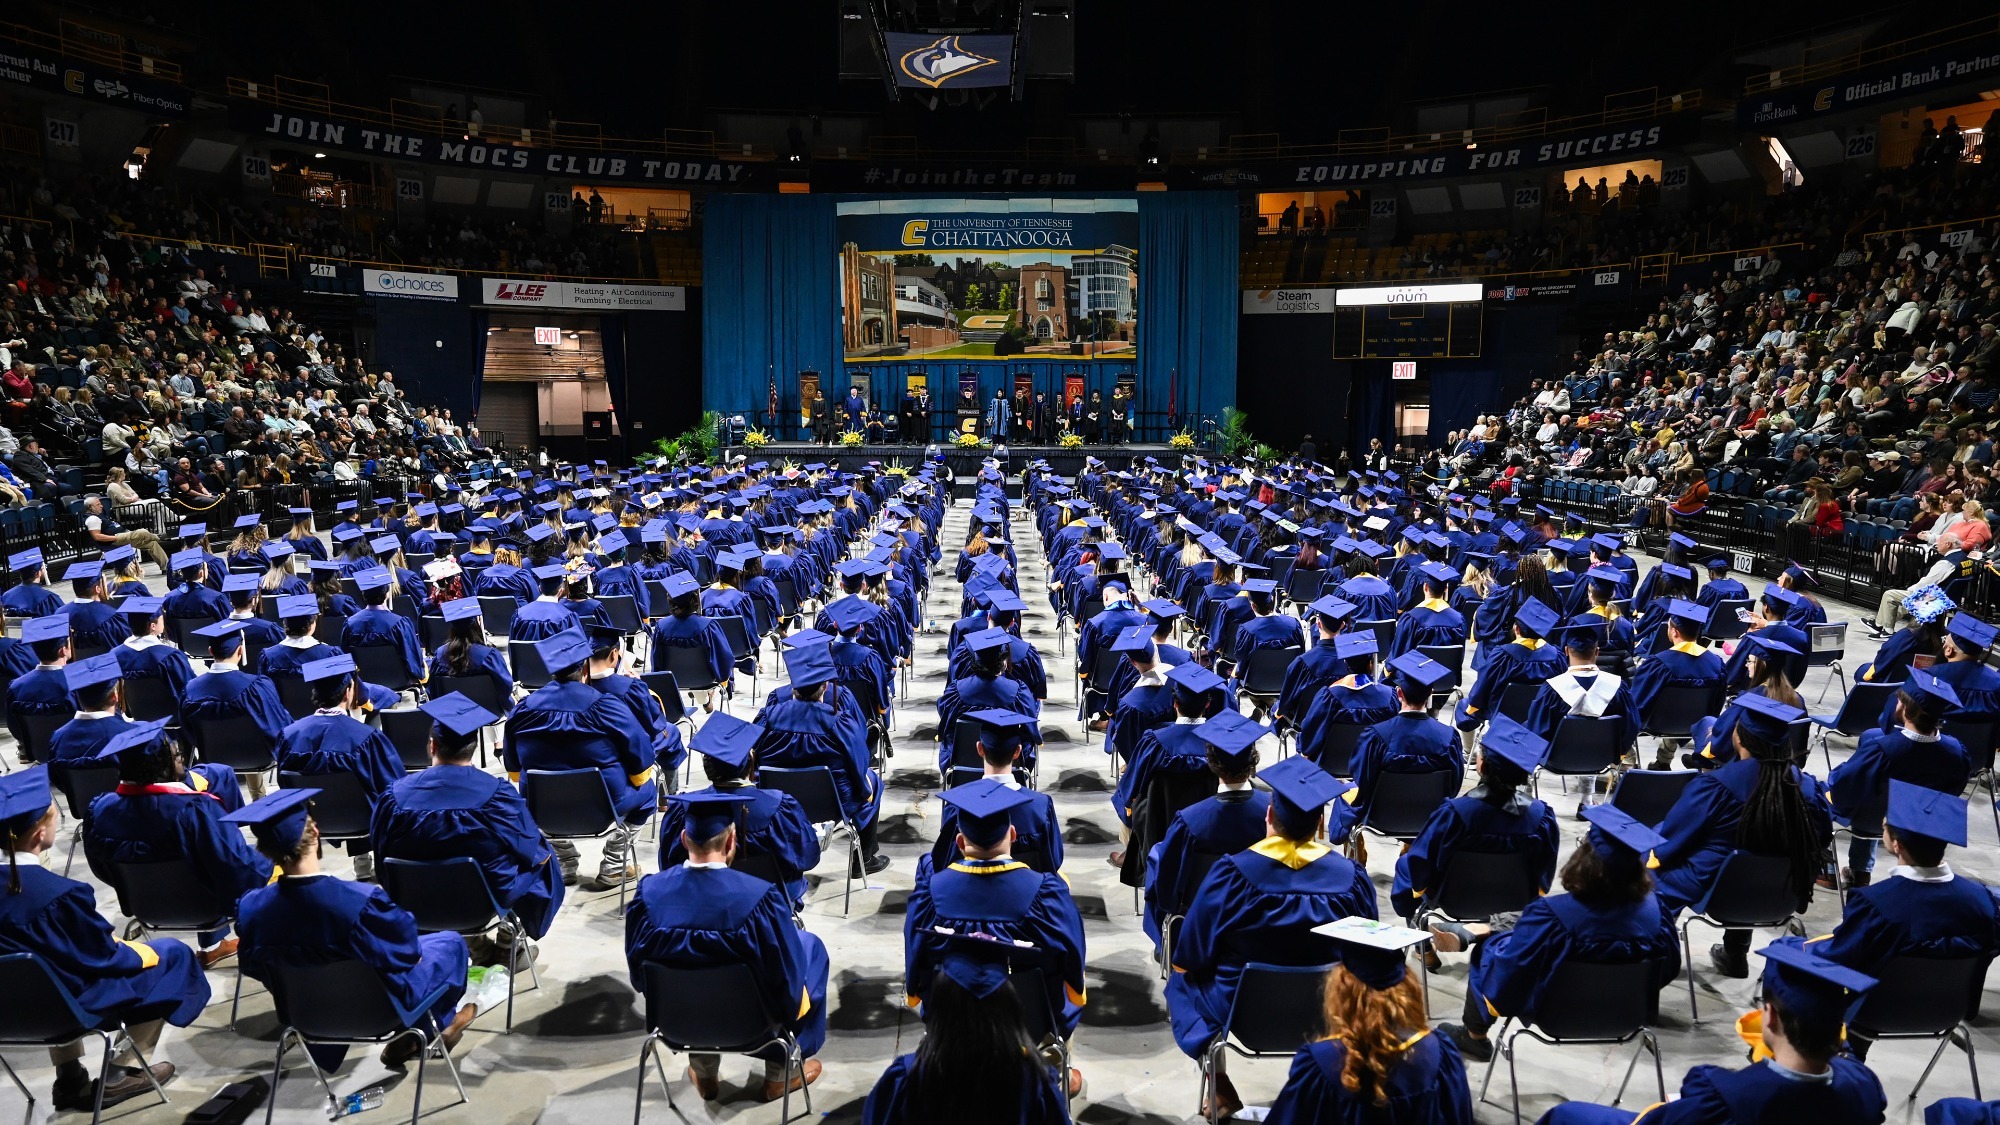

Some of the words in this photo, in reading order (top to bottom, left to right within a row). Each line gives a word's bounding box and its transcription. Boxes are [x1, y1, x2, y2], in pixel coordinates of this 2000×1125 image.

[33, 58, 57, 76] And
[1845, 75, 1897, 102] Official
[1901, 64, 1940, 88] Bank
[133, 92, 155, 105] Fiber
[156, 98, 184, 112] Optics
[1754, 104, 1798, 123] FirstBank
[50, 121, 75, 142] 217
[265, 113, 345, 145] JOIN
[361, 129, 423, 157] THE
[439, 141, 529, 169] MOCS
[546, 154, 627, 176] CLUB
[642, 160, 744, 182] TODAY
[1848, 134, 1874, 156] 226
[1295, 157, 1447, 183] EQUIPPING
[1468, 149, 1521, 170] FOR
[1537, 126, 1661, 162] SUCCESS
[245, 157, 267, 176] 218
[1202, 172, 1223, 182] MOCS
[1238, 172, 1259, 182] CLUB
[1663, 168, 1687, 186] 225
[400, 180, 420, 197] 219
[548, 194, 568, 209] 219
[1516, 189, 1540, 205] 224
[1372, 200, 1395, 214] 224
[932, 219, 951, 228] THE
[952, 219, 1006, 228] UNIVERSITY
[1008, 219, 1020, 228] OF
[1021, 218, 1073, 228] TENNESSEE
[932, 230, 1073, 247] CHATTANOOGA
[1946, 231, 1968, 246] 127
[395, 275, 445, 292] choices
[1599, 273, 1615, 284] 125
[514, 283, 548, 297] LEE
[574, 287, 604, 297] Heating
[611, 288, 622, 296] Air
[624, 288, 675, 298] Conditioning
[1277, 291, 1312, 301] Steam
[1387, 291, 1428, 303] unum
[574, 296, 611, 305] Plumbing
[618, 297, 653, 305] Electrical
[1276, 301, 1320, 312] Logistics
[537, 329, 560, 343] EXIT
[1394, 363, 1415, 378] EXIT
[1735, 555, 1751, 572] 102
